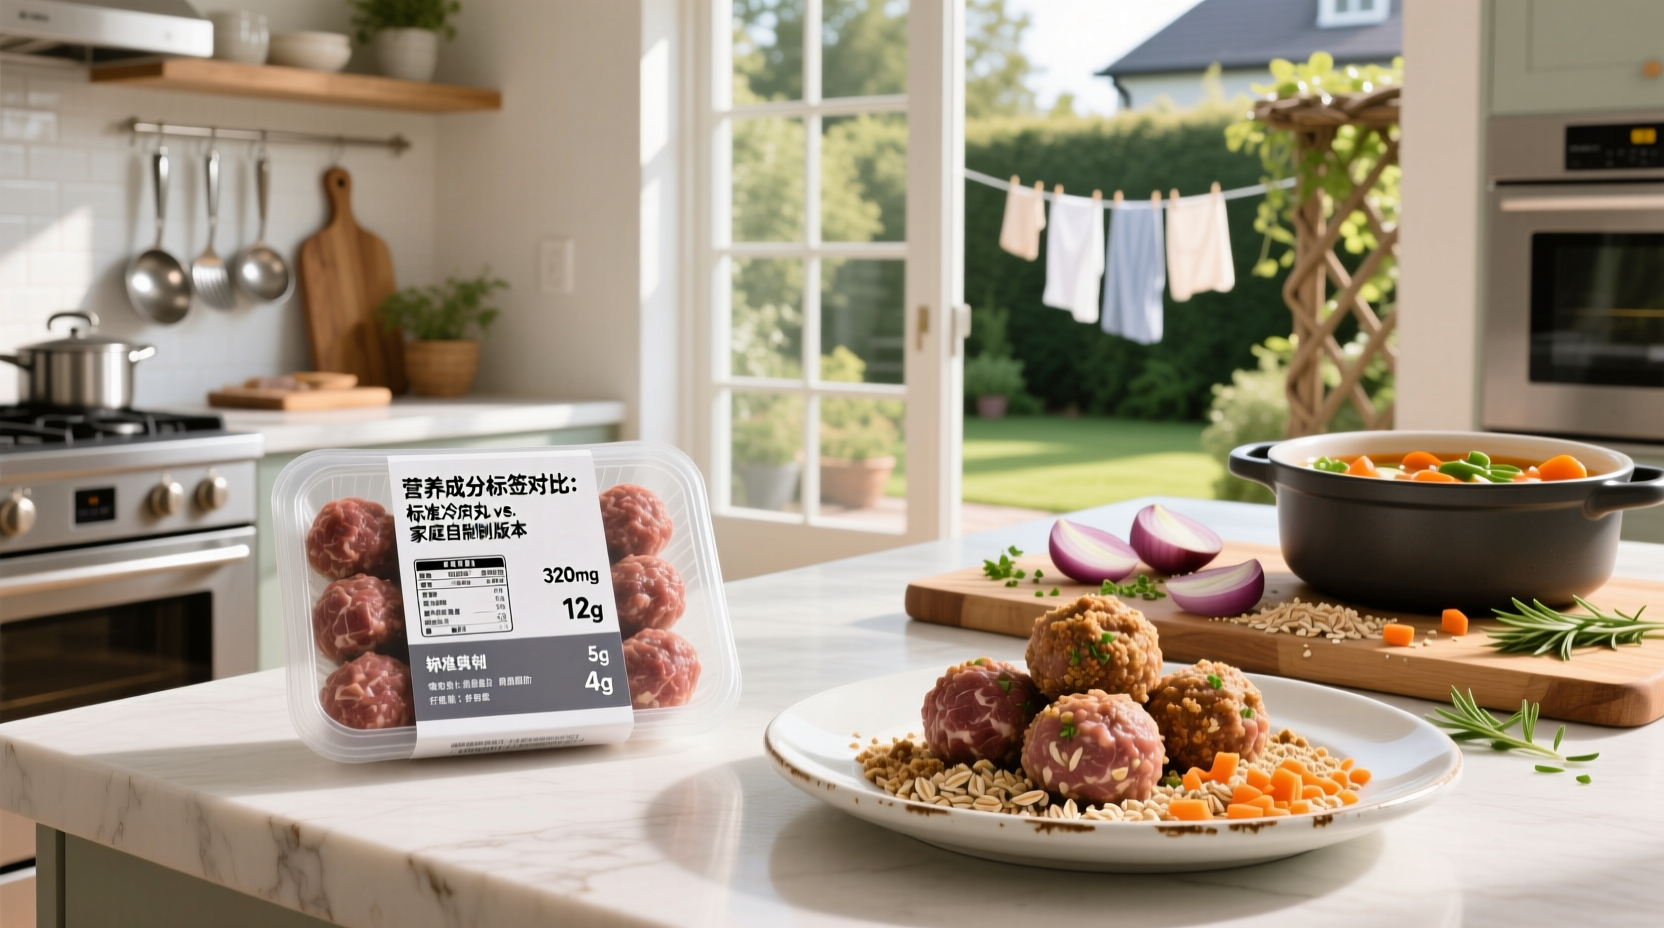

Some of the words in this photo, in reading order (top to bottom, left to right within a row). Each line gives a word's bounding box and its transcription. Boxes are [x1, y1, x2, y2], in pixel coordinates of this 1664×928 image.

[543, 566, 599, 584] 320mg
[562, 597, 603, 623] 12g
[588, 645, 609, 666] 5g
[585, 670, 613, 696] 4g
